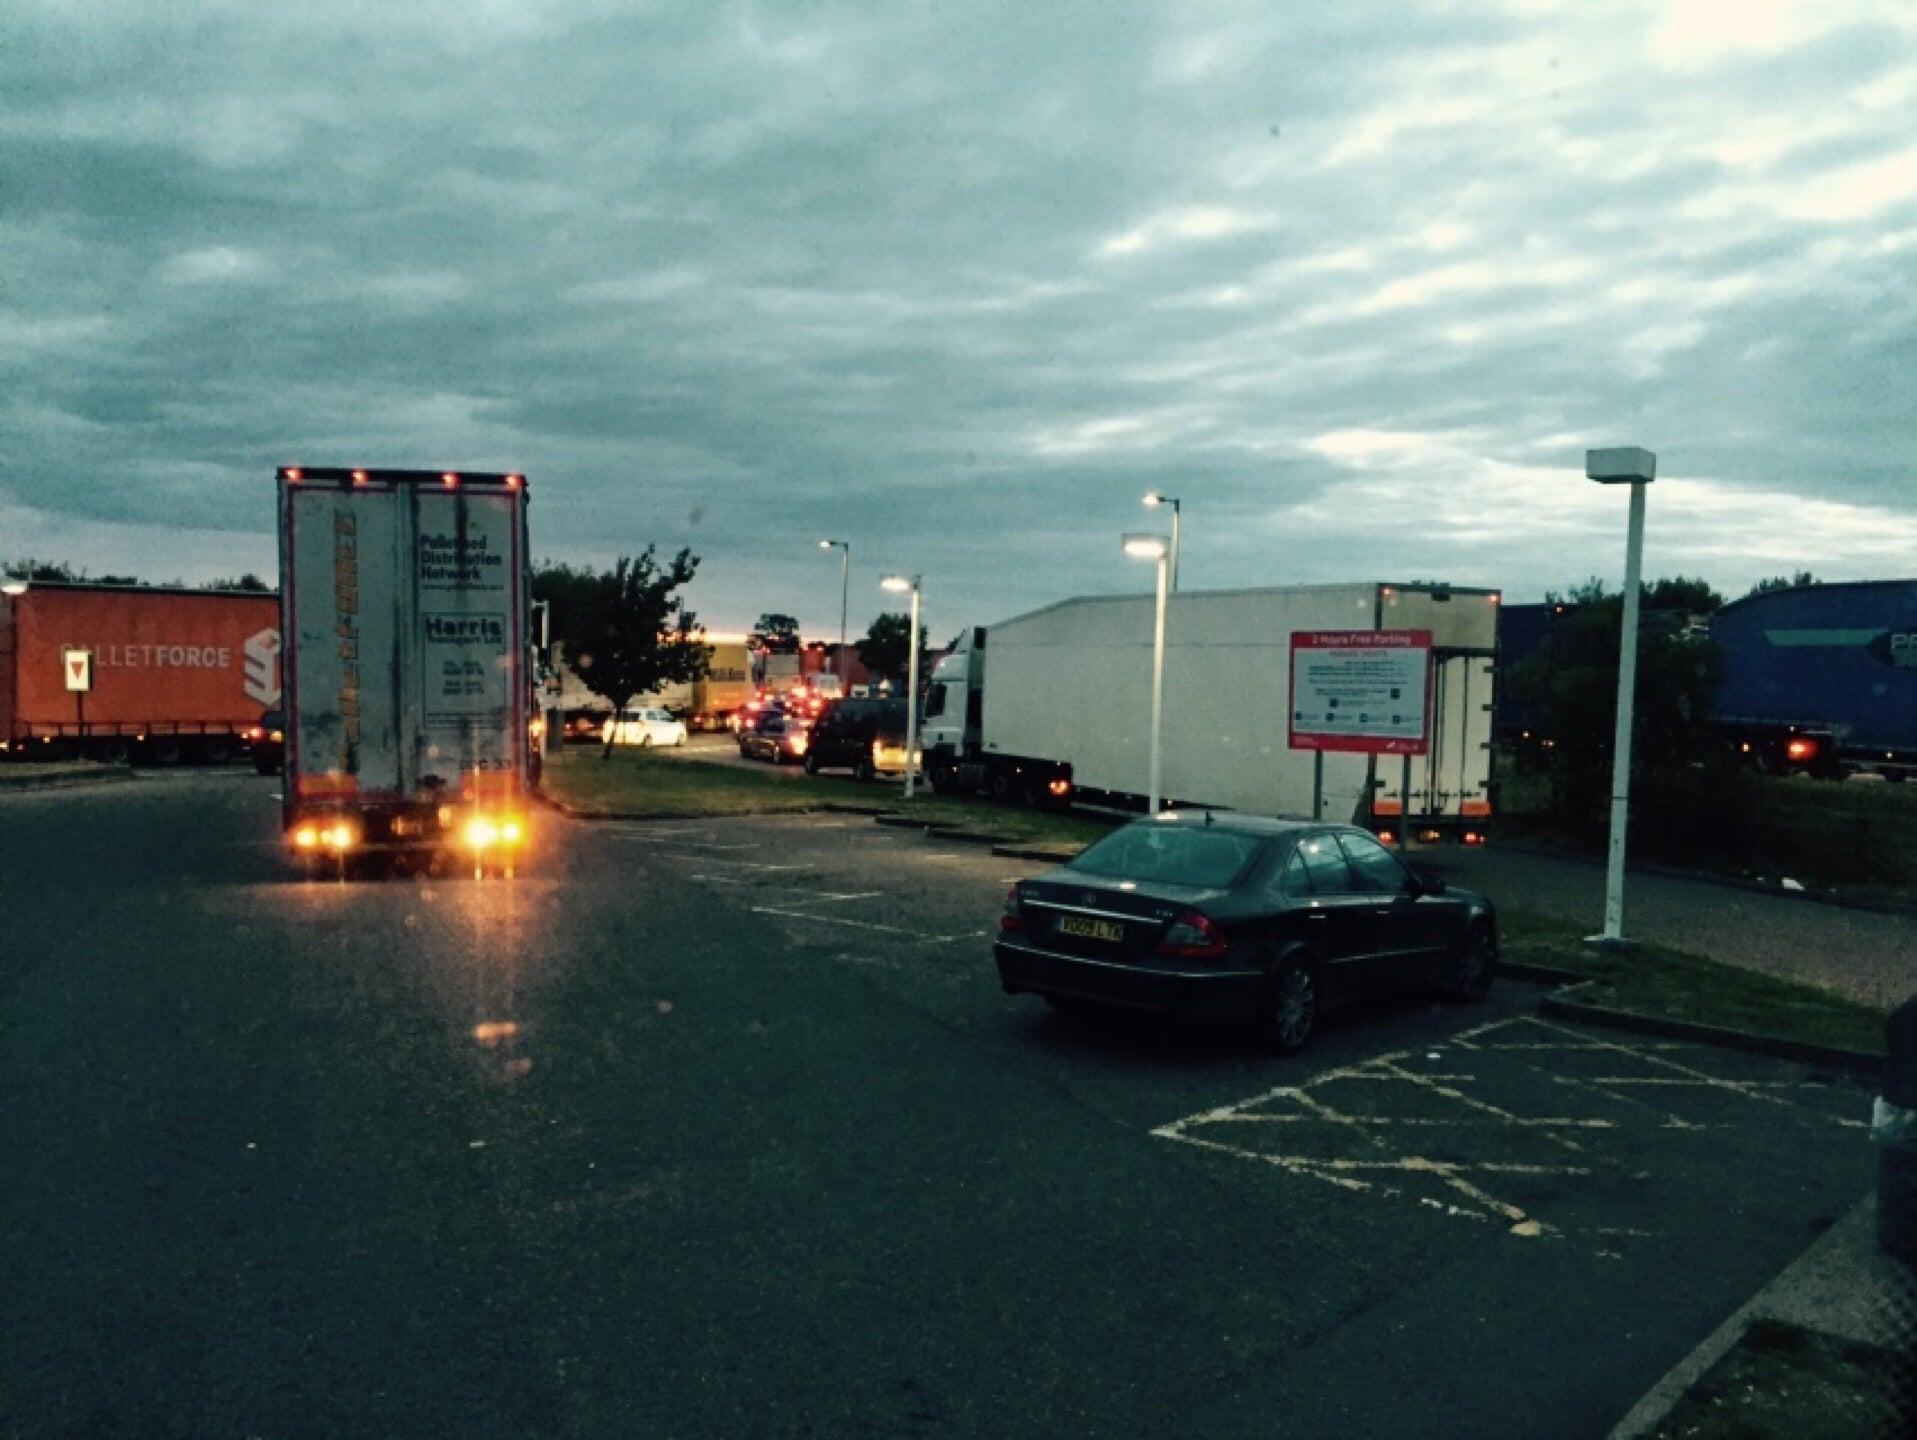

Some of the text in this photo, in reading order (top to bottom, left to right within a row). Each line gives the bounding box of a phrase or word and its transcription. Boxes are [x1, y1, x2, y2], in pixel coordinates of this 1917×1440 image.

[420, 551, 502, 565] Distriution
[424, 617, 502, 636] Harris
[60, 643, 231, 668] PLLETFORCE
